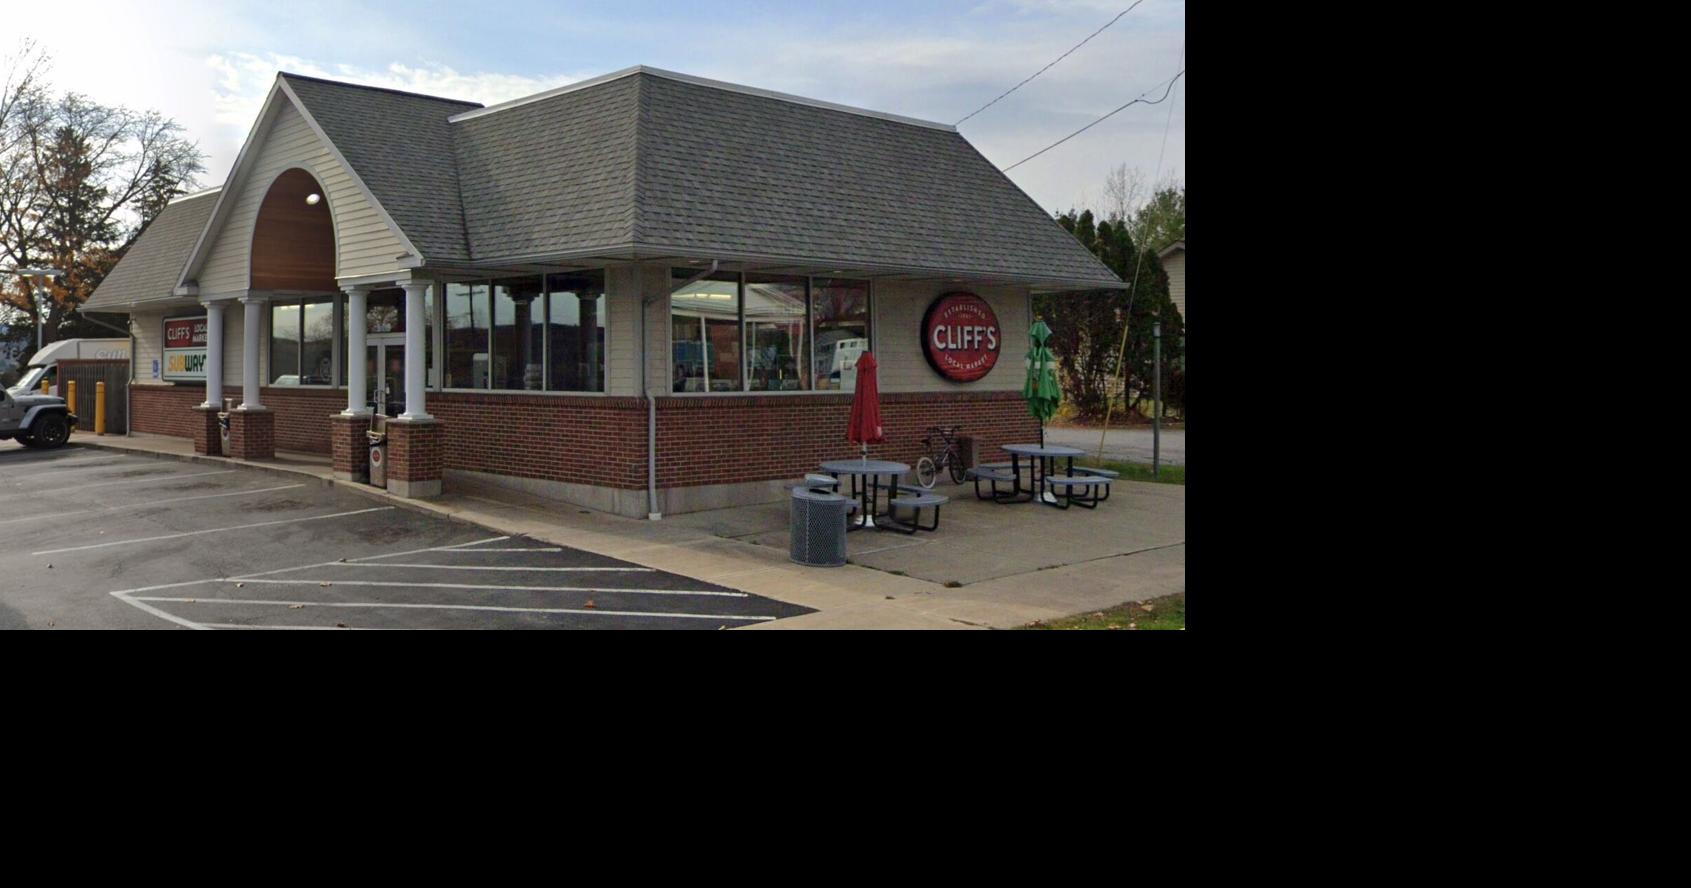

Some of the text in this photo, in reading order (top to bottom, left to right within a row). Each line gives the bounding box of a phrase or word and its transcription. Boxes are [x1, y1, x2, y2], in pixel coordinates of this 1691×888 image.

[944, 304, 986, 320] ESTABLISHED
[933, 325, 997, 350] CLIFF'S
[168, 352, 207, 373] SUBWAY
[944, 353, 988, 369] LOCAL MARKET
